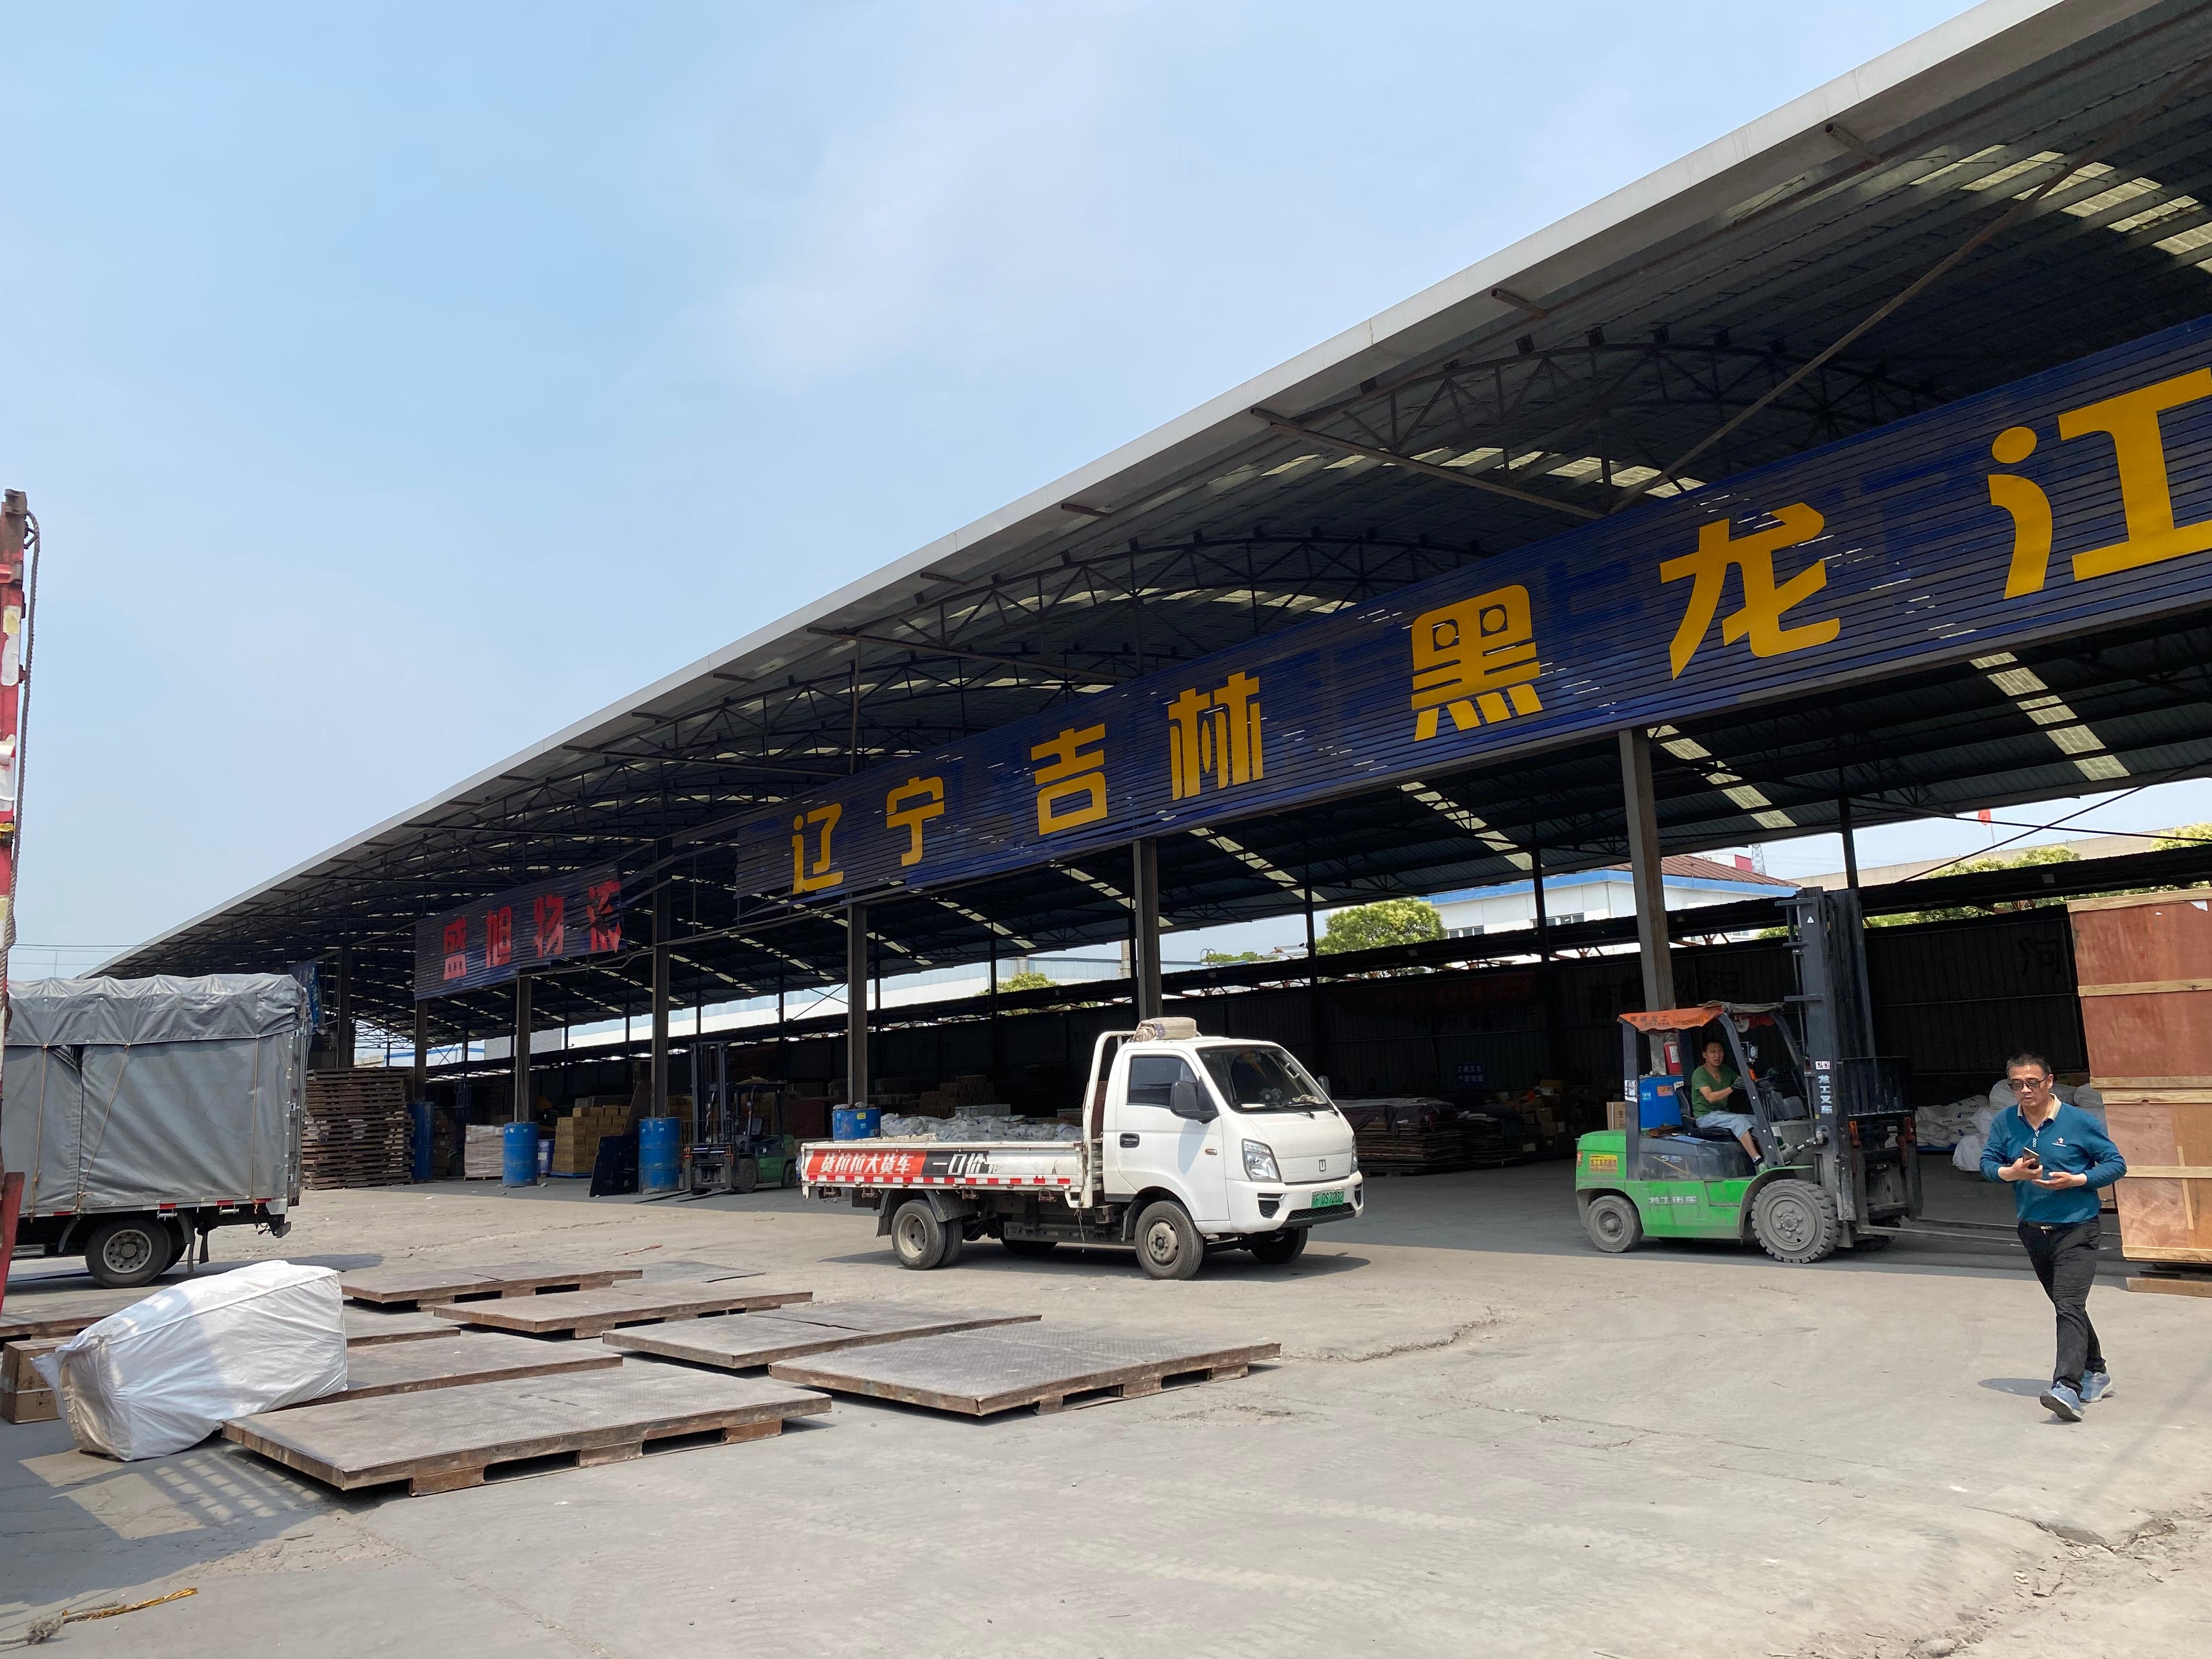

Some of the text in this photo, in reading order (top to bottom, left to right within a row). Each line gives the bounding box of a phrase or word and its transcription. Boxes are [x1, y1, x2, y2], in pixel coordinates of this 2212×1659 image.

[791, 368, 2212, 894] 辽宁 吉林 黑龙江
[820, 1152, 915, 1174] 货拉拉大货车
